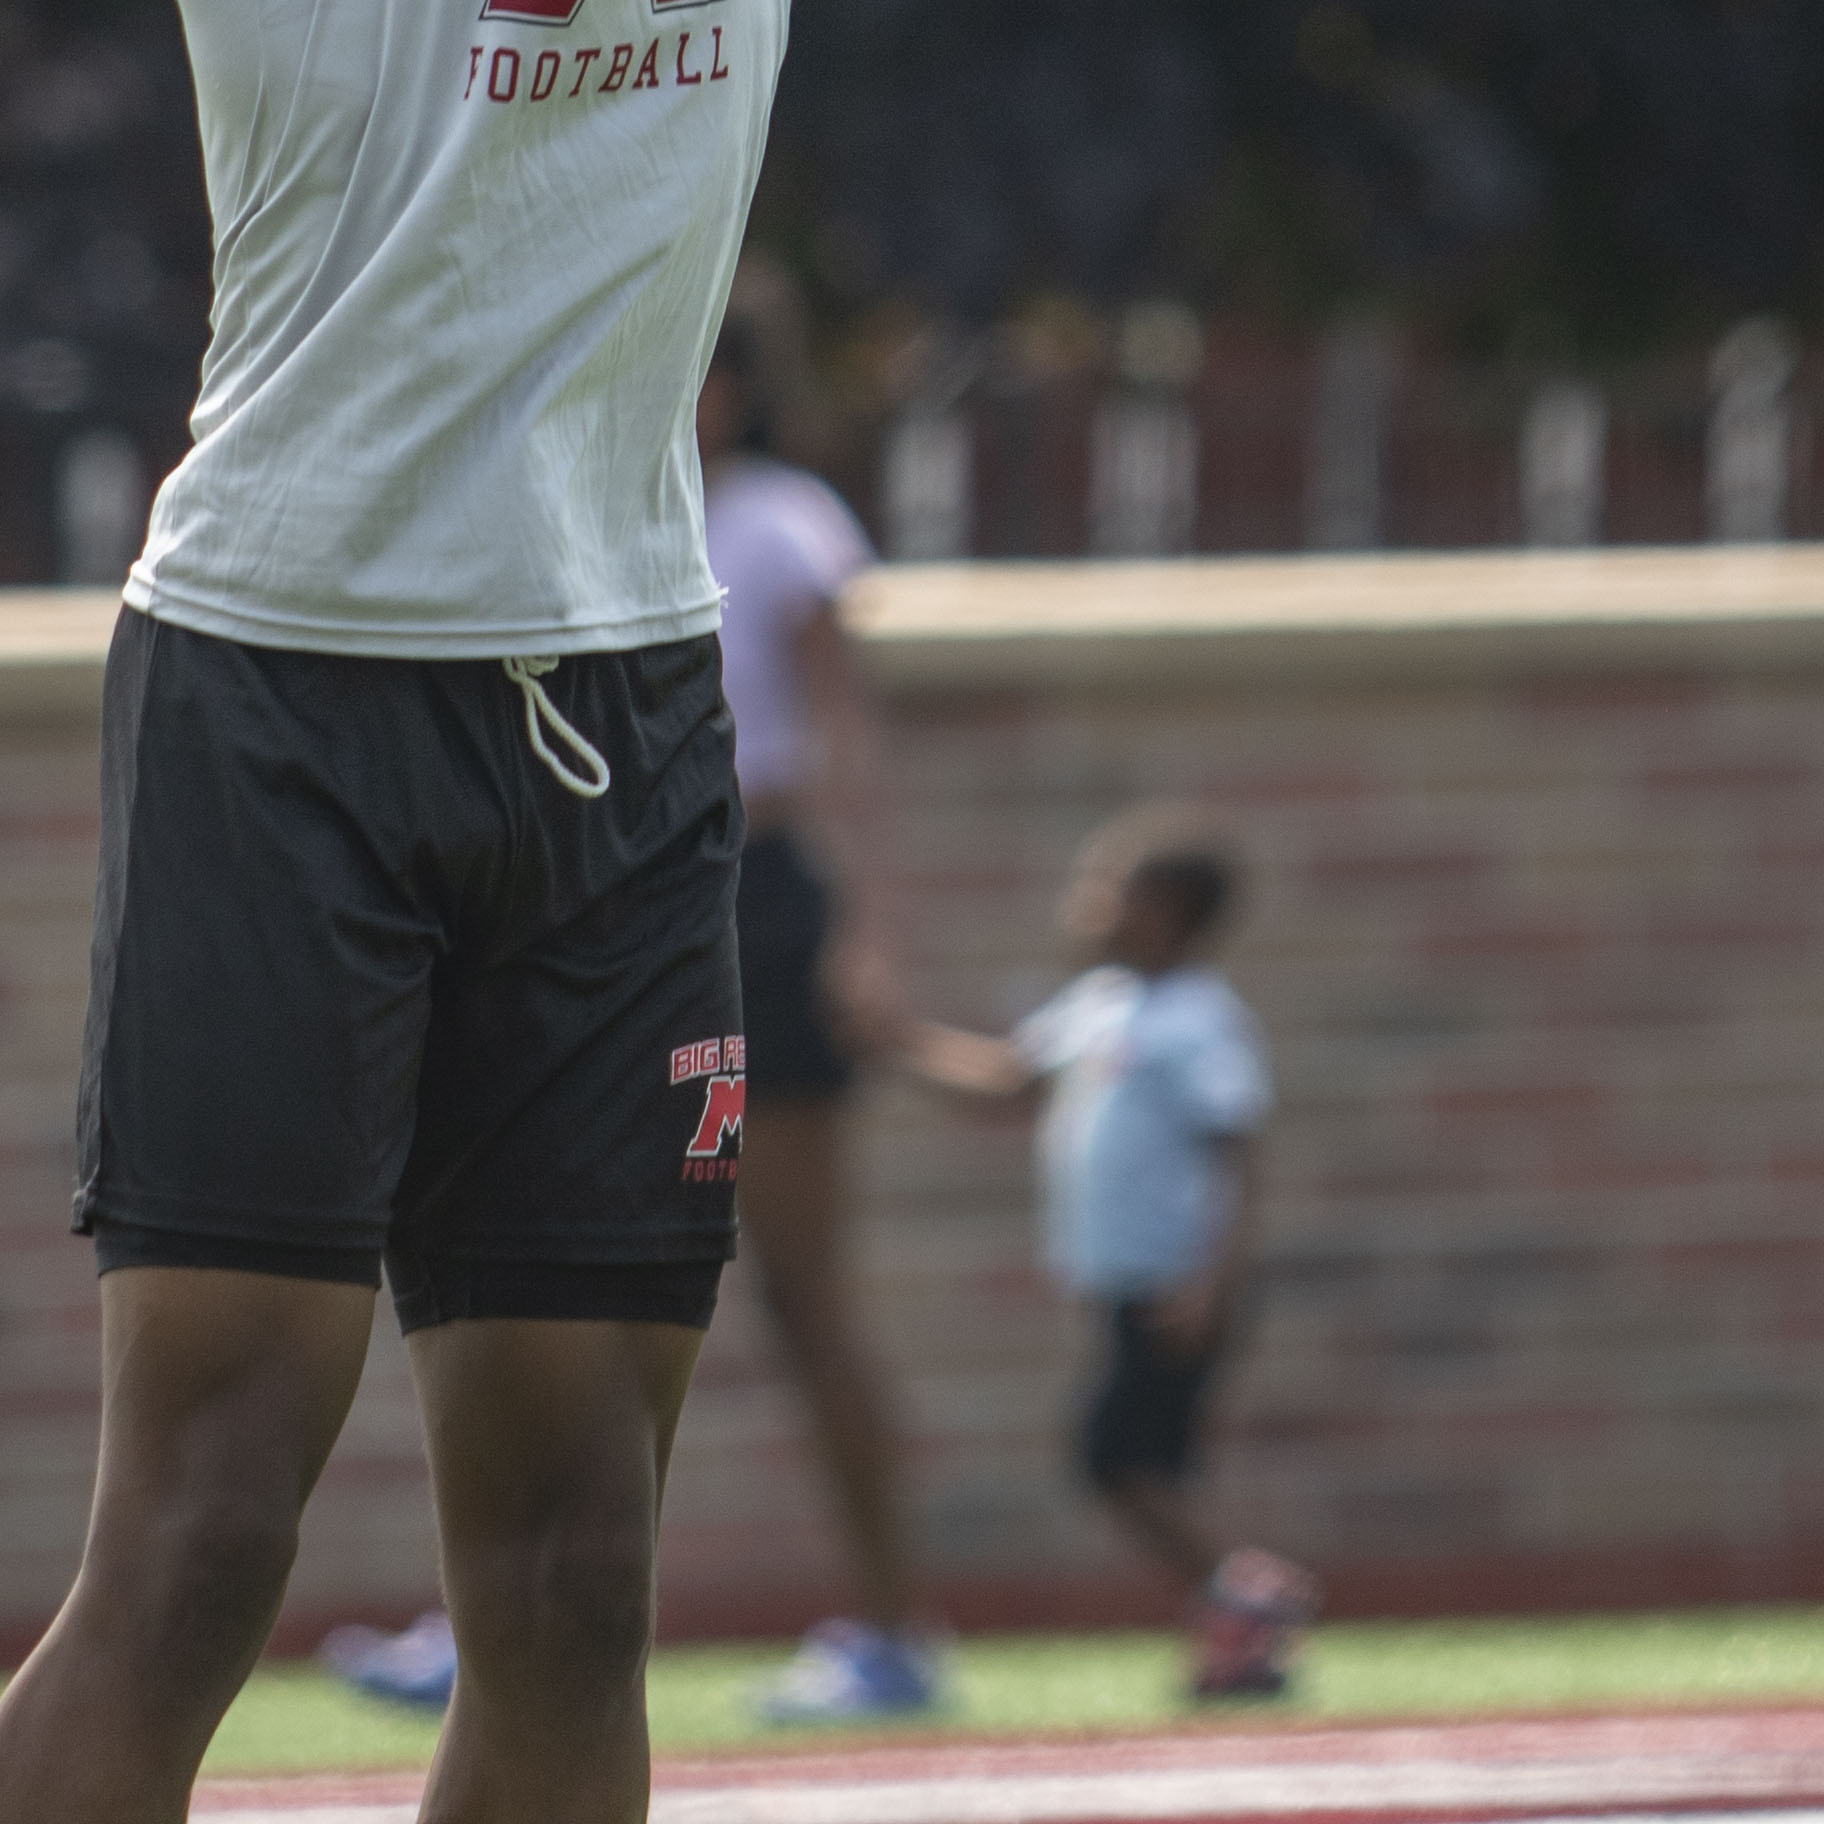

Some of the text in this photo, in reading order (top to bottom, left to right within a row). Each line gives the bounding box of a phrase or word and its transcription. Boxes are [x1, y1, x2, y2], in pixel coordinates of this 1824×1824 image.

[463, 26, 729, 103] FOOTBALL
[670, 1034, 746, 1087] BIG RE
[686, 1074, 746, 1158] M
[682, 1158, 737, 1183] FOOTB
